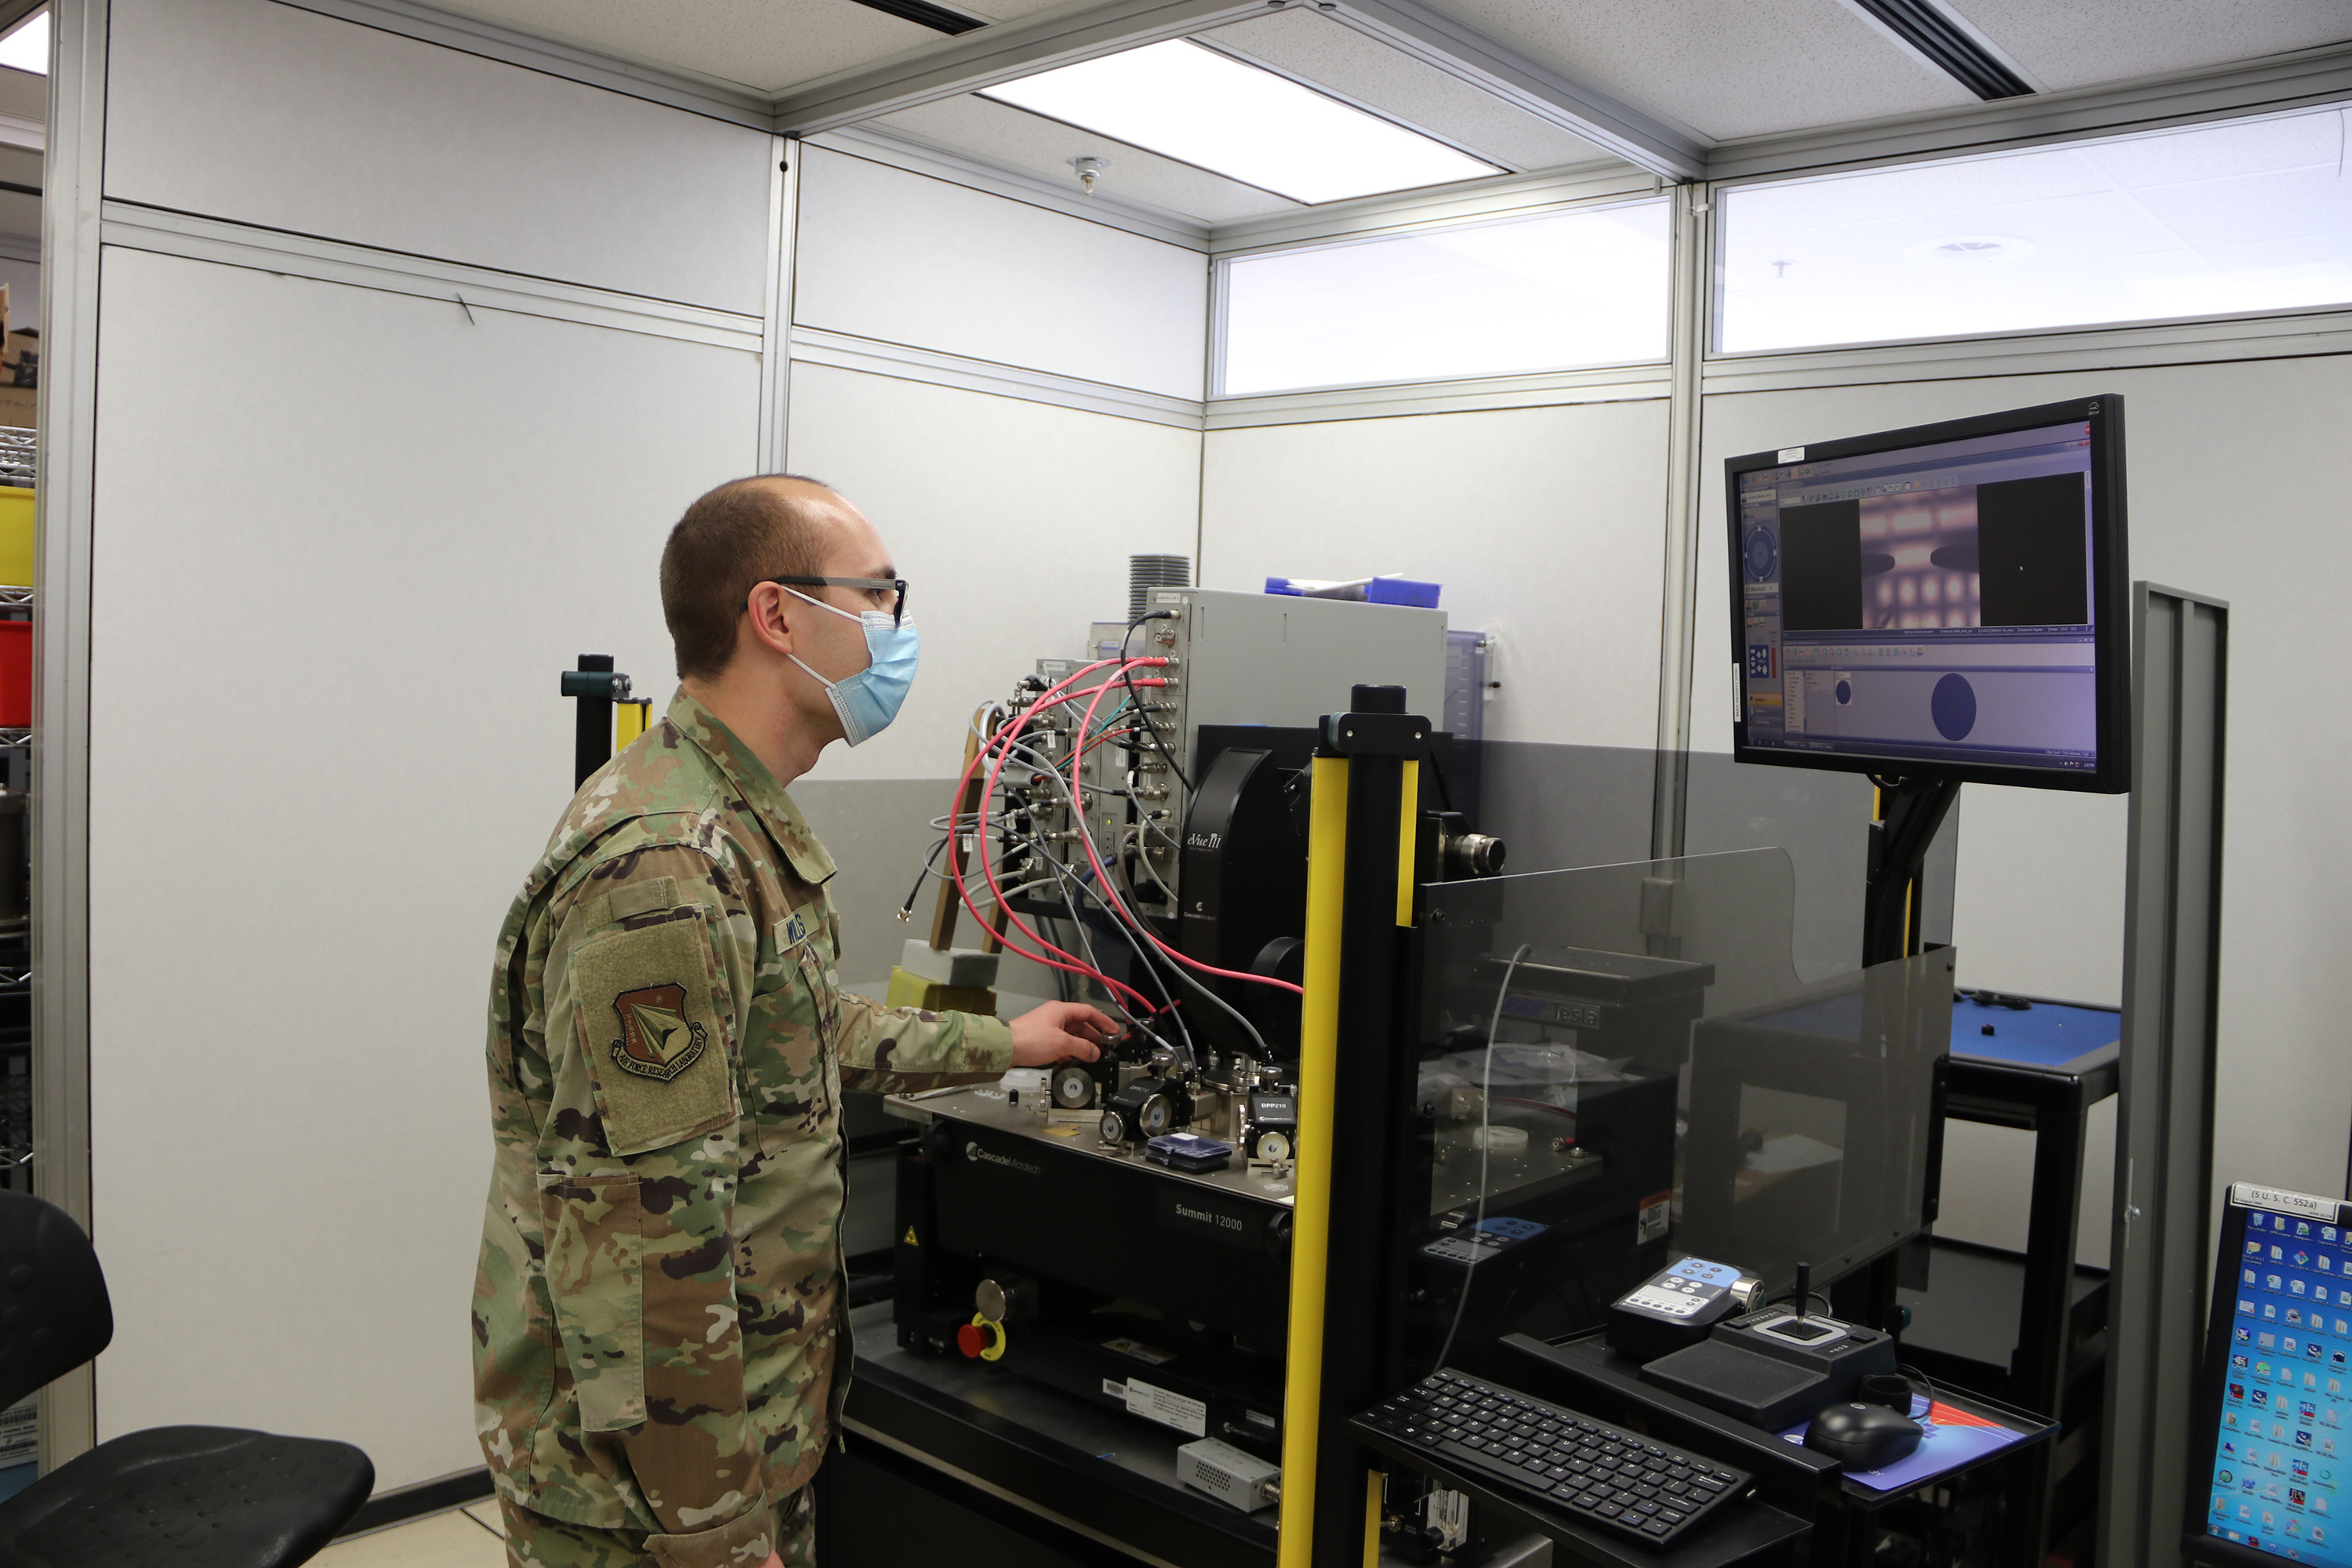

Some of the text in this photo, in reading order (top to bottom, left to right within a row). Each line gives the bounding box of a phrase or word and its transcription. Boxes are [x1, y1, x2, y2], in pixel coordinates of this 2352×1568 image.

[1187, 833, 1208, 846] eVue
[1552, 1001, 1598, 1025] Tesla
[619, 1054, 630, 1066] AIR
[628, 1061, 648, 1074] FORCE
[648, 1065, 678, 1079] RESEARCH
[2252, 1190, 2259, 1199] (5
[2273, 1194, 2281, 1203] S.
[2293, 1198, 2317, 1210] 552a)
[1175, 1203, 1243, 1231] Summit 12000
